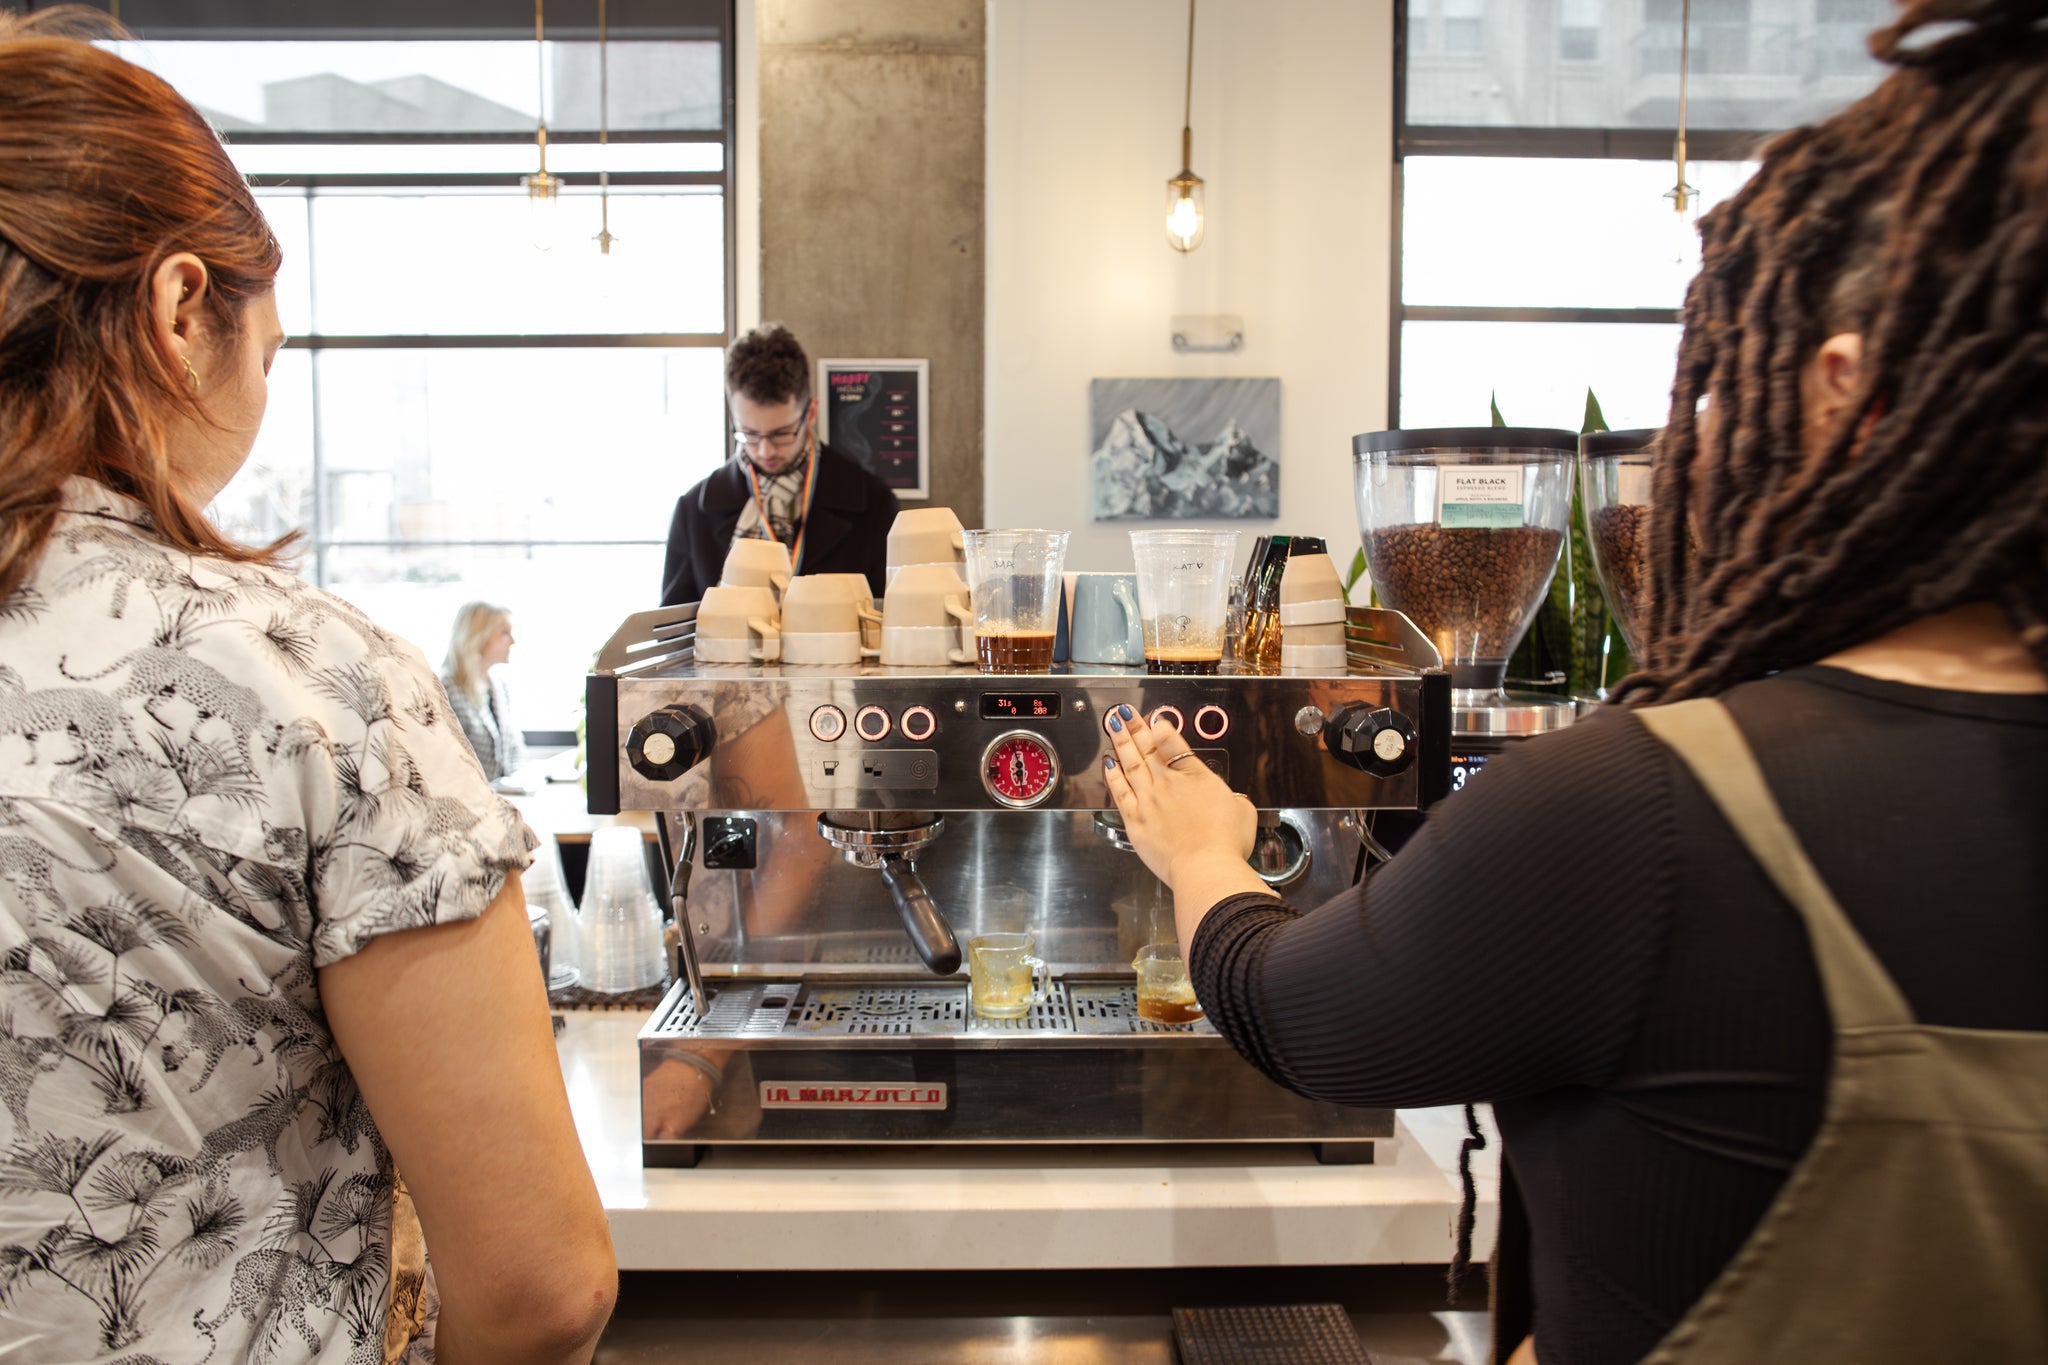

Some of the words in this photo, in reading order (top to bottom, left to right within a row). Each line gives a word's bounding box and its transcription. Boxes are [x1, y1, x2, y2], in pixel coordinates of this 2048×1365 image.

[998, 699, 1012, 707] 31s
[767, 1088, 790, 1103] LA
[800, 1088, 940, 1103] MARZOCCO
